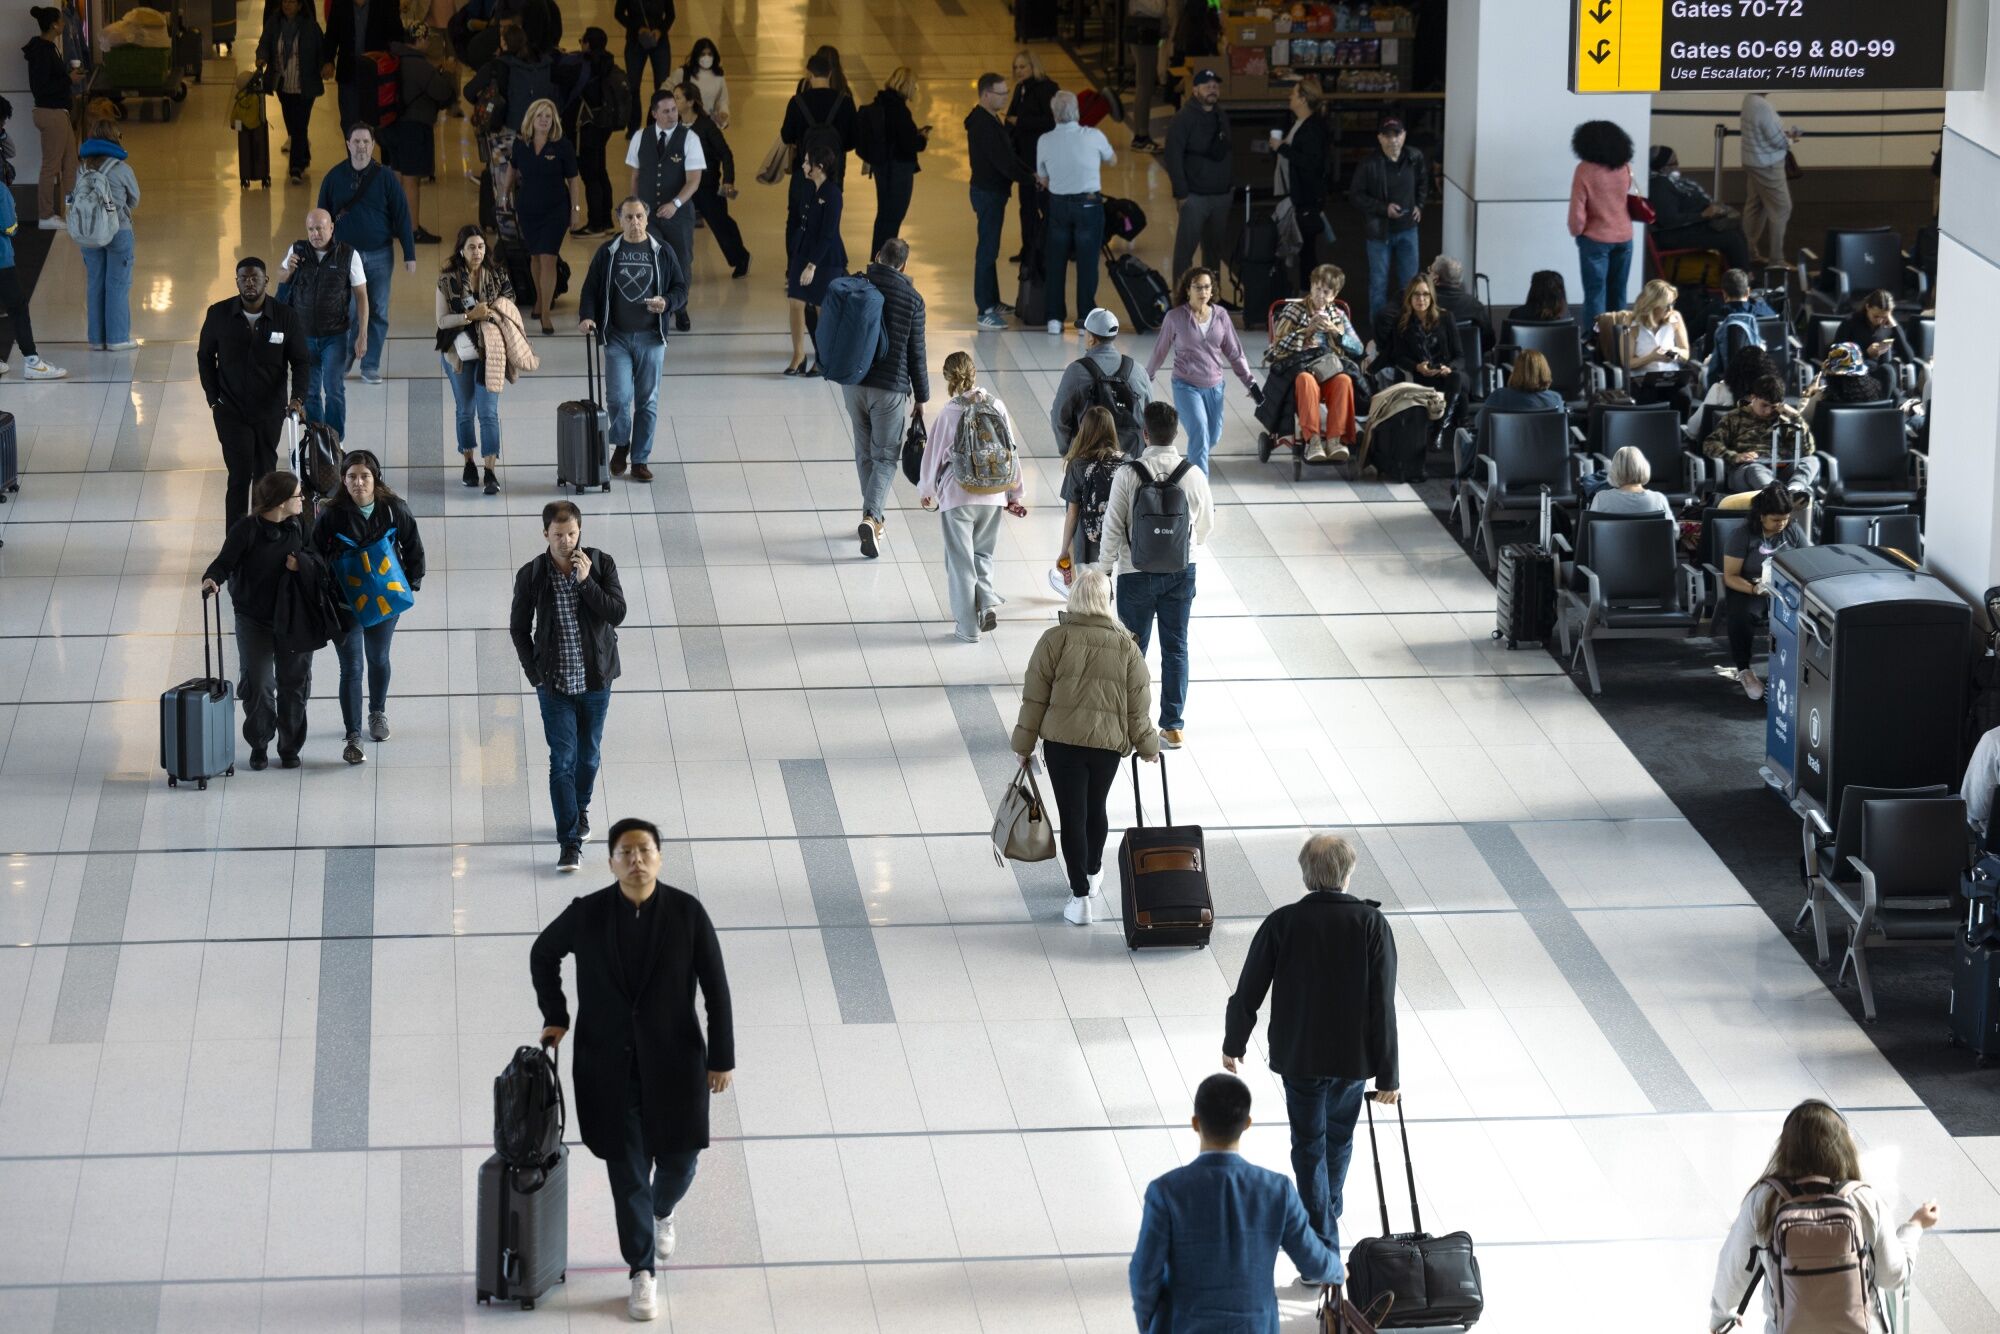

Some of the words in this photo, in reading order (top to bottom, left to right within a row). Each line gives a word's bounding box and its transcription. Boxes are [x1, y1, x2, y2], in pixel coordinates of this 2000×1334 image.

[1671, 0, 1732, 18] Gates
[1738, 0, 1802, 18] 70-72
[1670, 40, 1731, 59] Gates
[1736, 40, 1801, 59] 60-69
[1808, 39, 1824, 58] &
[1829, 39, 1895, 58] 80-99
[1670, 67, 1697, 80] Use
[1700, 66, 1771, 81] Escalator;
[1776, 65, 1806, 79] 7-15
[1809, 65, 1864, 79] Minutes
